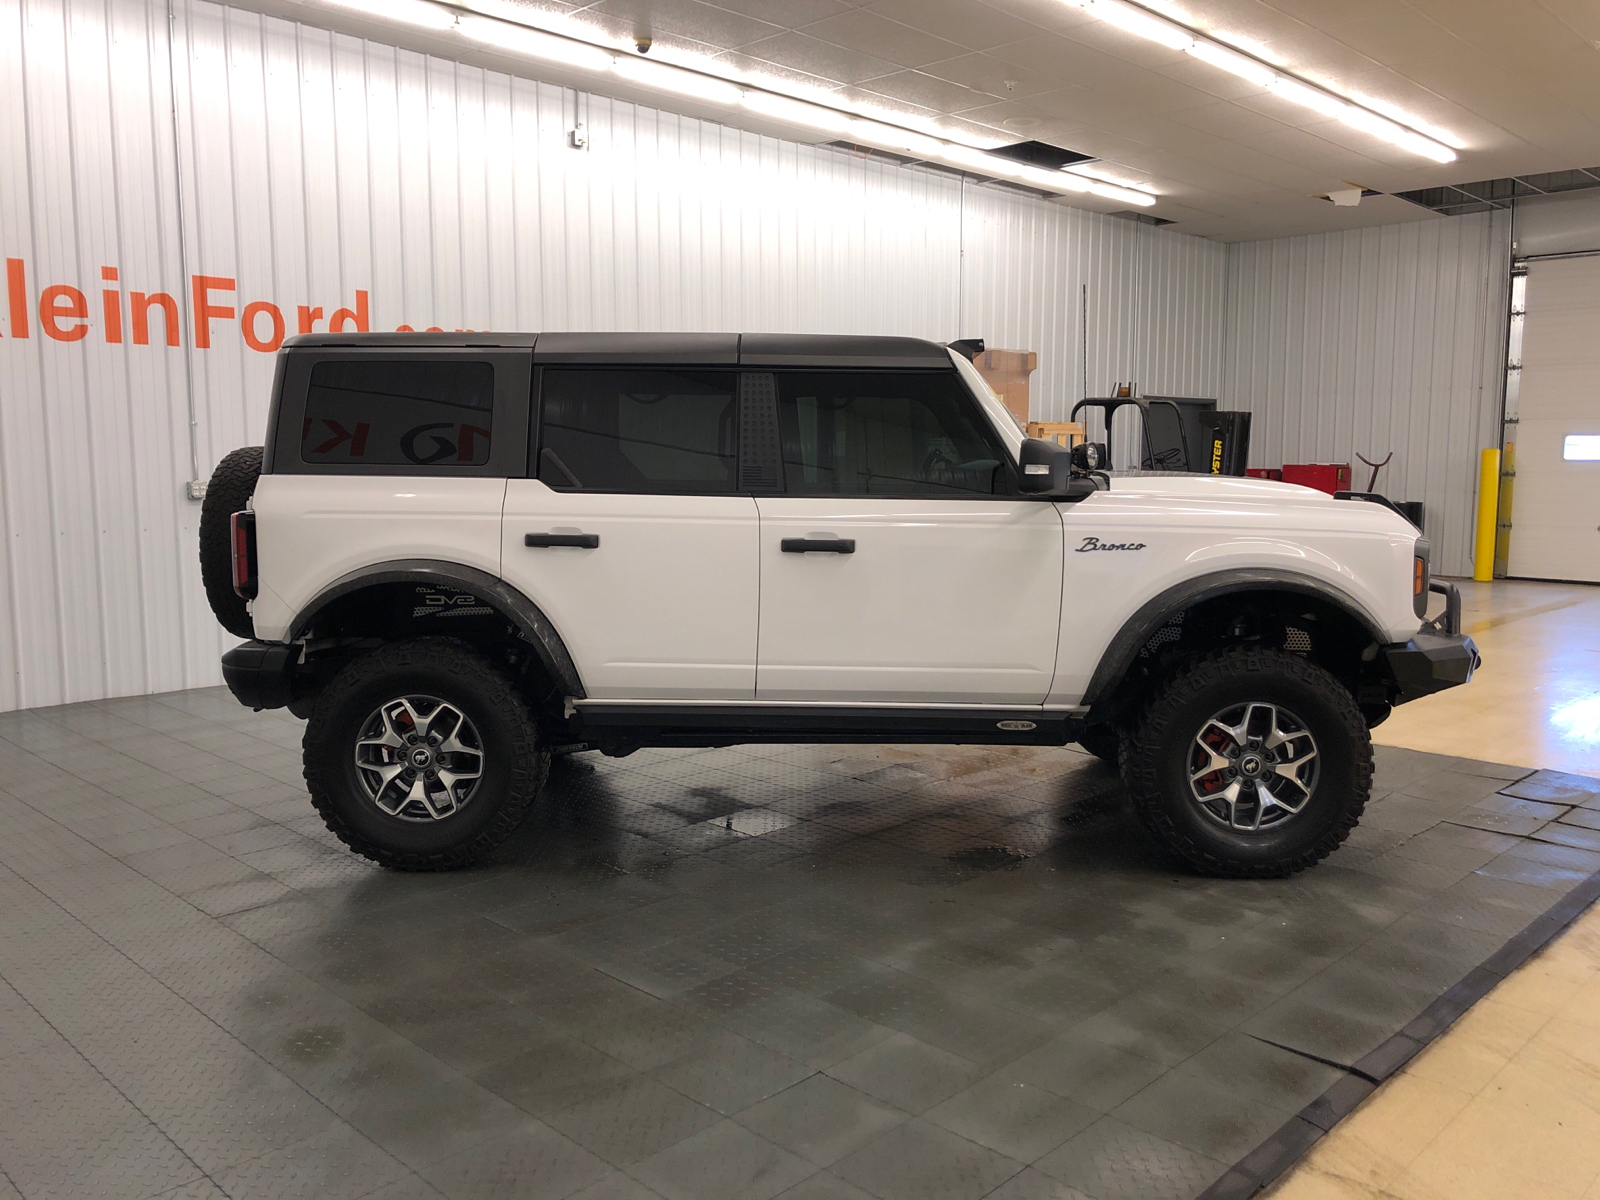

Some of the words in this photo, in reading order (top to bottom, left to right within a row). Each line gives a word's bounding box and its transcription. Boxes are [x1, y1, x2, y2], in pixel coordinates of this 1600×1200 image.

[0, 257, 369, 353] leinFord
[1211, 439, 1223, 475] YSTER
[1074, 536, 1147, 552] Bronco
